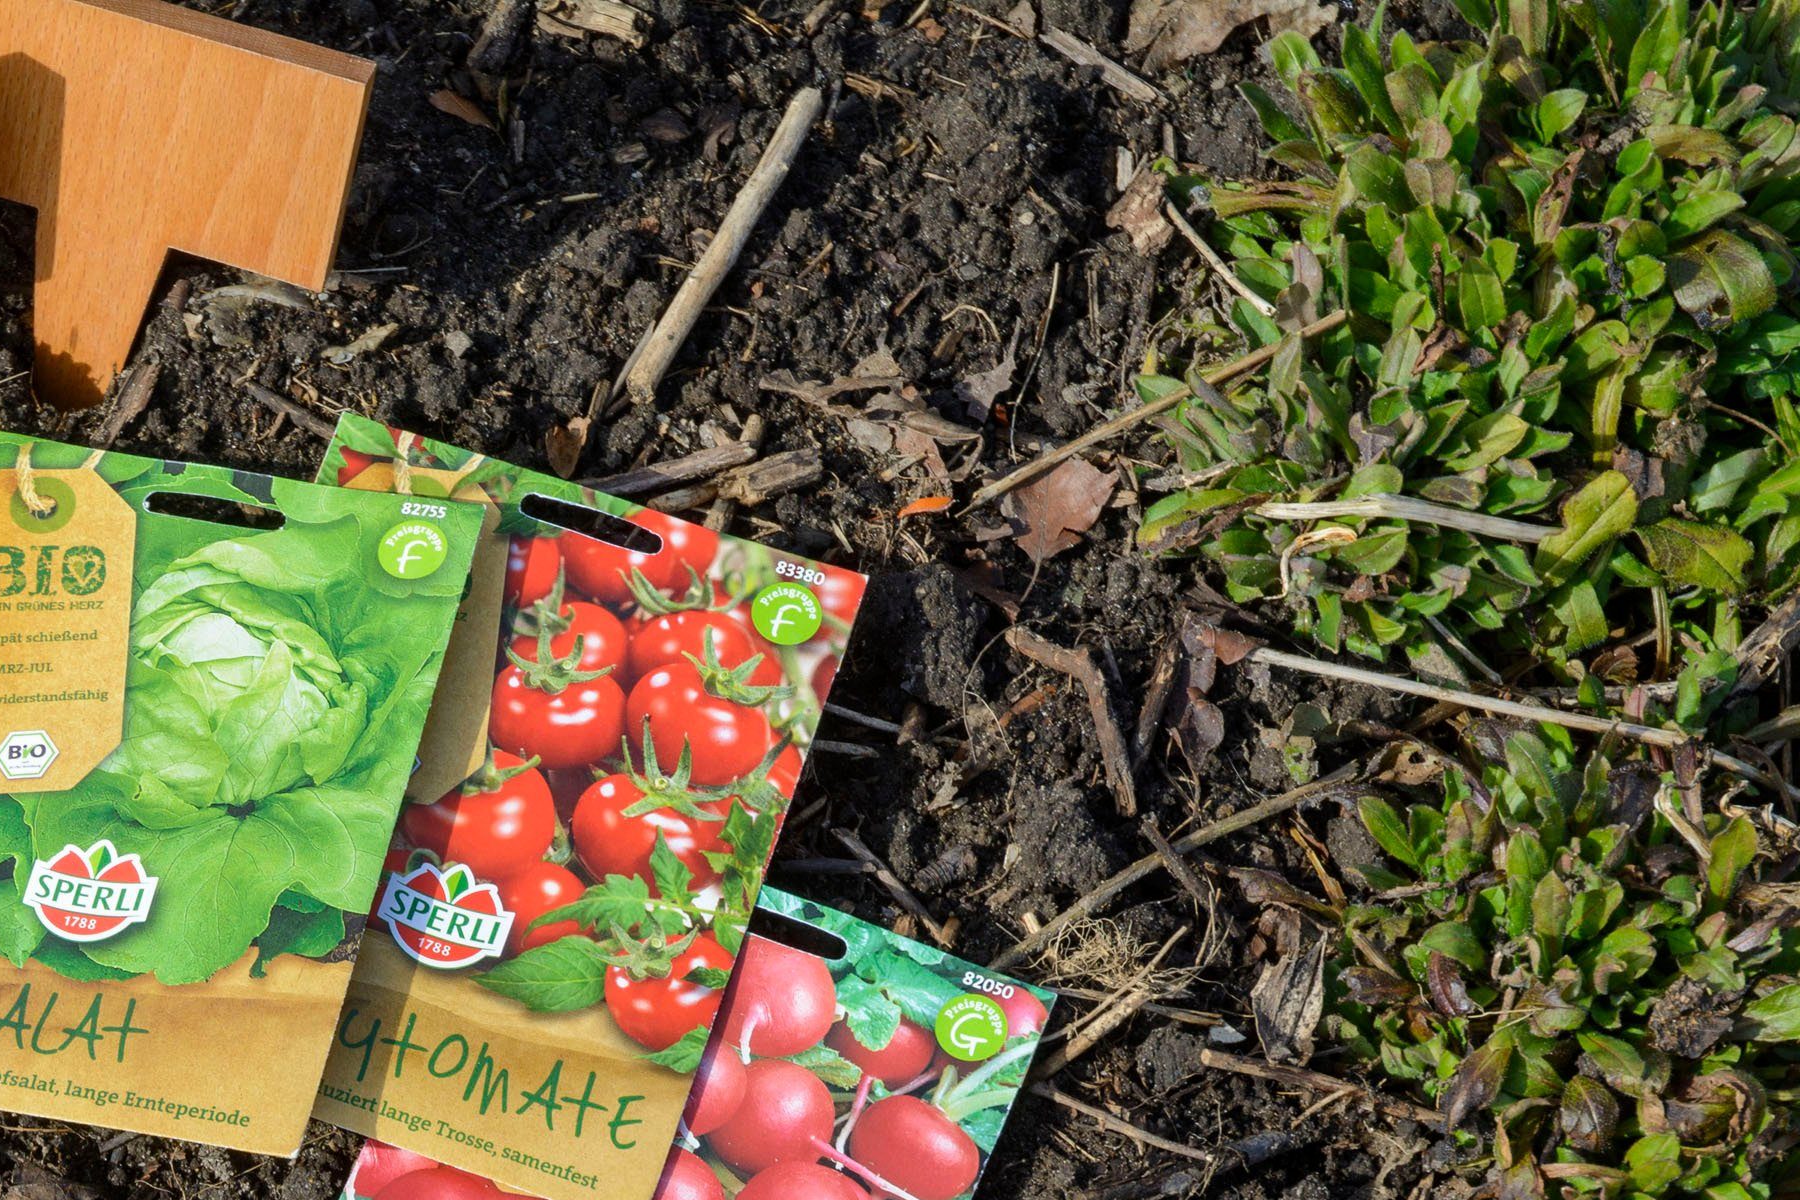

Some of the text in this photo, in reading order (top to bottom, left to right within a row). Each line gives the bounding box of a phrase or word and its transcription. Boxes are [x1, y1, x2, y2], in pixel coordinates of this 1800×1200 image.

[400, 502, 448, 519] 82755
[385, 525, 443, 552] Preisgruppe
[775, 560, 826, 586] 83380
[16, 600, 65, 612] GRÜNES
[69, 600, 104, 611] HERZ
[759, 587, 817, 620] Preisgruppe
[26, 629, 98, 643] schießend
[34, 874, 145, 912] SPERLI
[64, 915, 97, 930] 1788
[389, 888, 502, 945] SPERLI
[417, 937, 452, 957] 1788
[962, 971, 1015, 1000] 82050
[944, 998, 1003, 1036] Preisgruppe
[950, 1012, 988, 1057] G
[63, 1080, 119, 1105] lange
[123, 1091, 252, 1128] Ernteperiode
[379, 1100, 432, 1131] lange
[435, 1120, 499, 1158] Trosse,
[501, 1145, 599, 1190] samenfest
